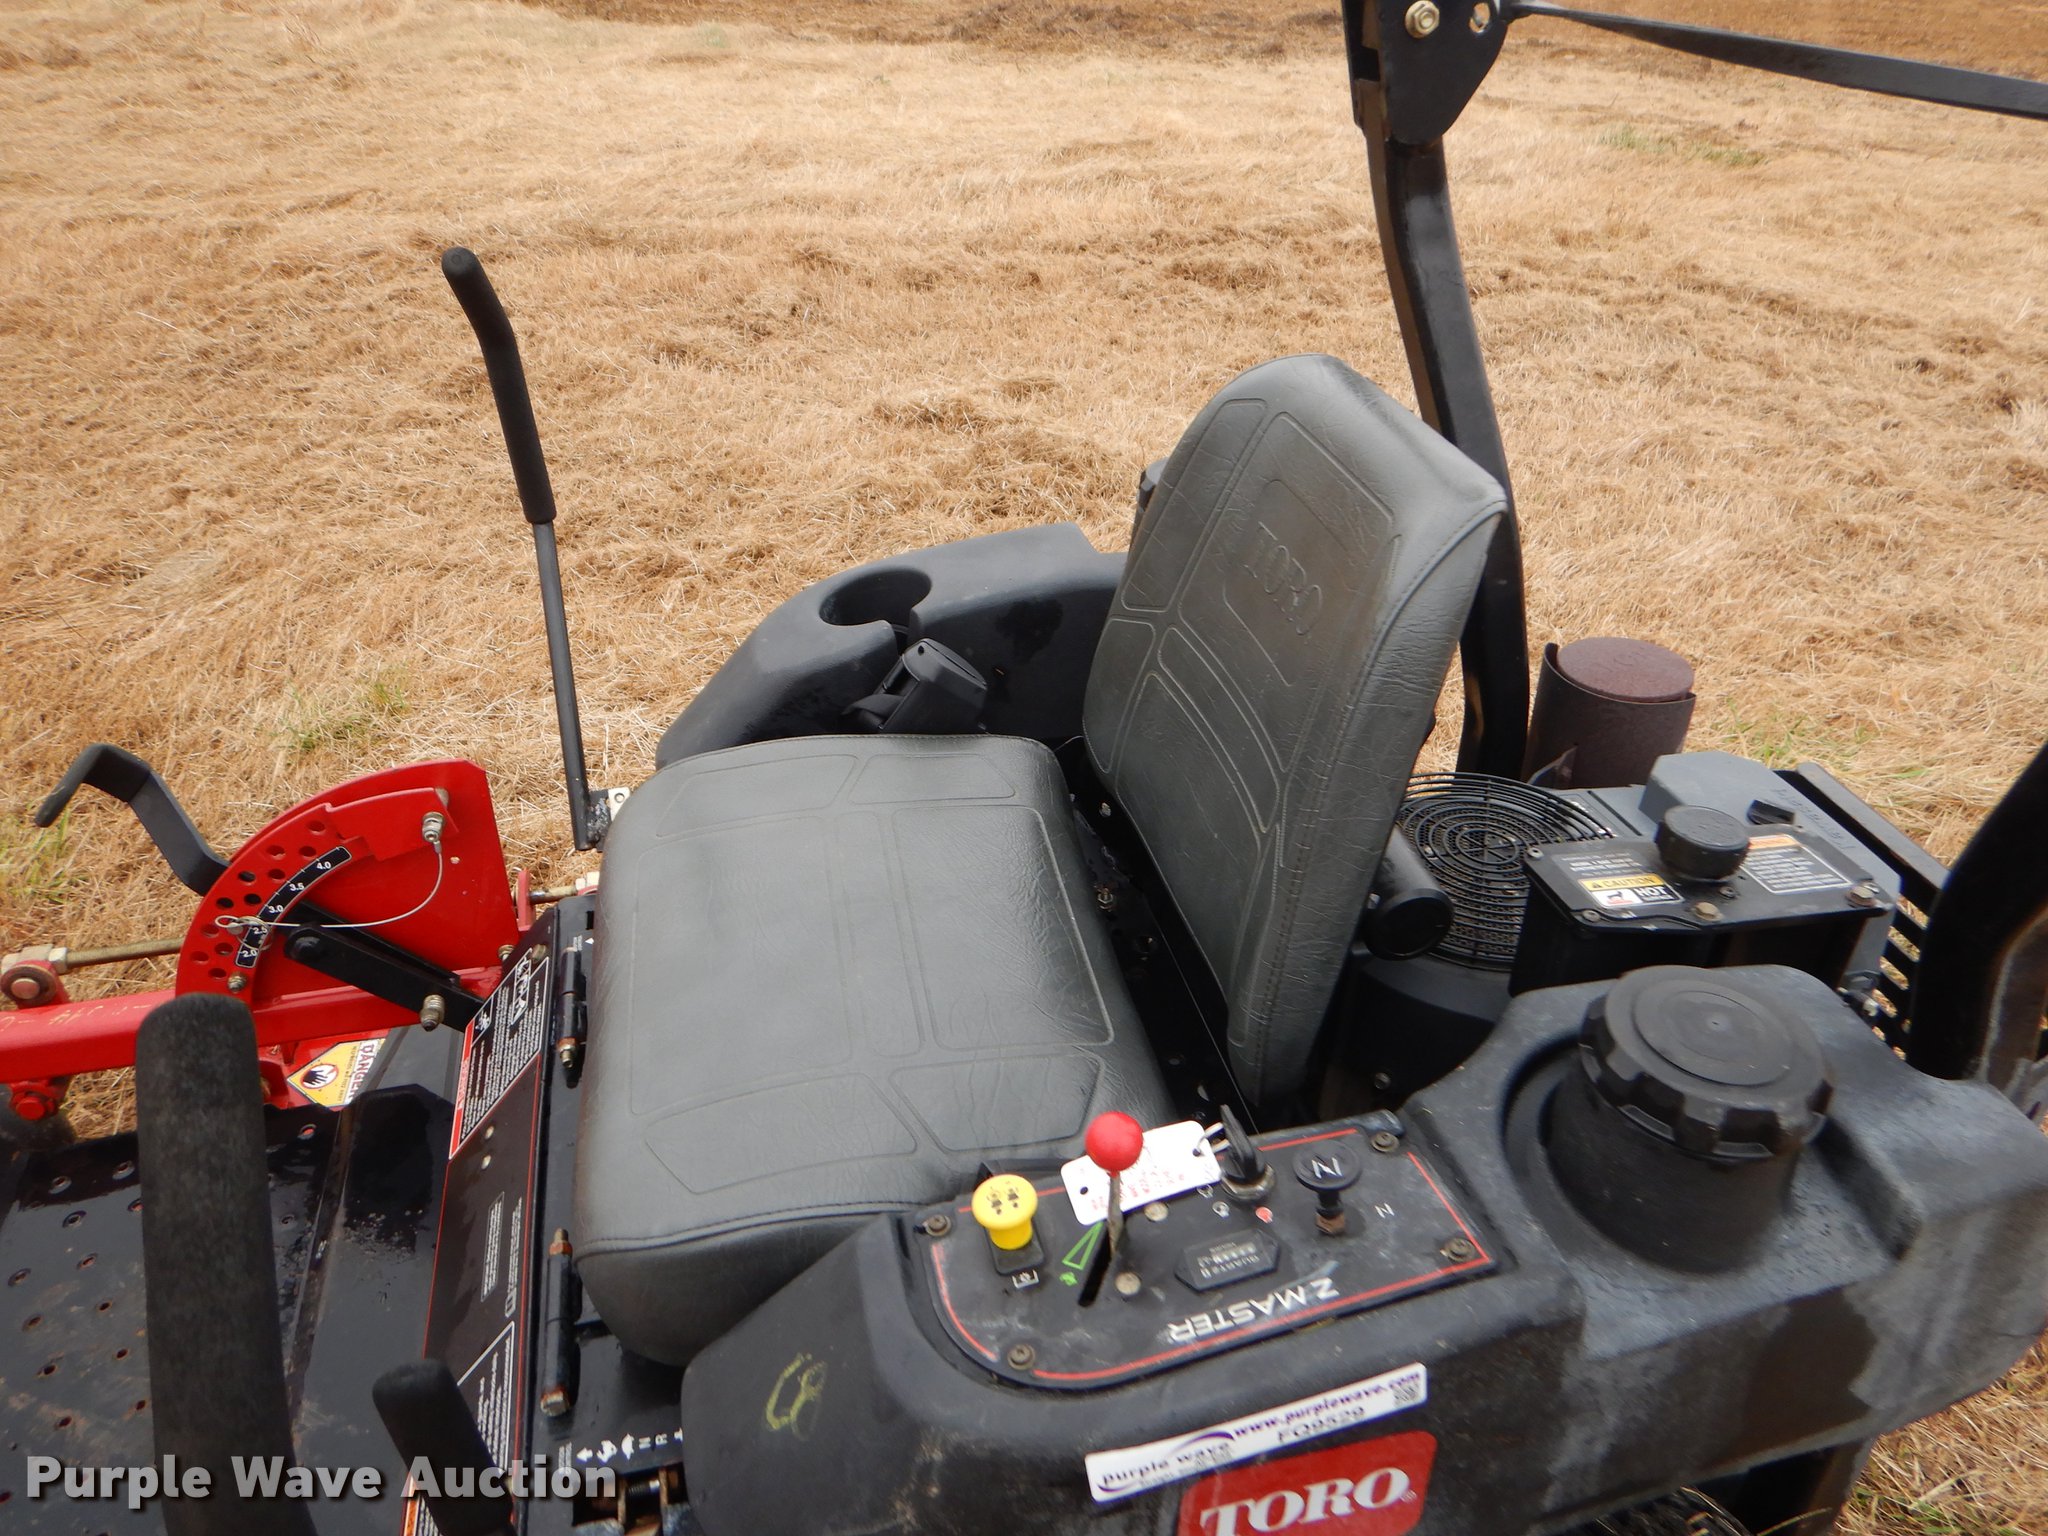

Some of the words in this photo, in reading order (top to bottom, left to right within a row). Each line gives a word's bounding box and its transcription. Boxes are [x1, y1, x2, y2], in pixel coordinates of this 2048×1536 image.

[316, 861, 332, 870] 4.0
[289, 882, 305, 891] 3.5
[1602, 876, 1655, 888] CAUTION
[1633, 886, 1668, 897] HOT
[268, 904, 284, 914] 3.0
[1168, 1286, 1313, 1343] MASTER
[1100, 1457, 1170, 1487] purple
[1176, 1440, 1234, 1467] wave
[1199, 1466, 1411, 1536] TORO
